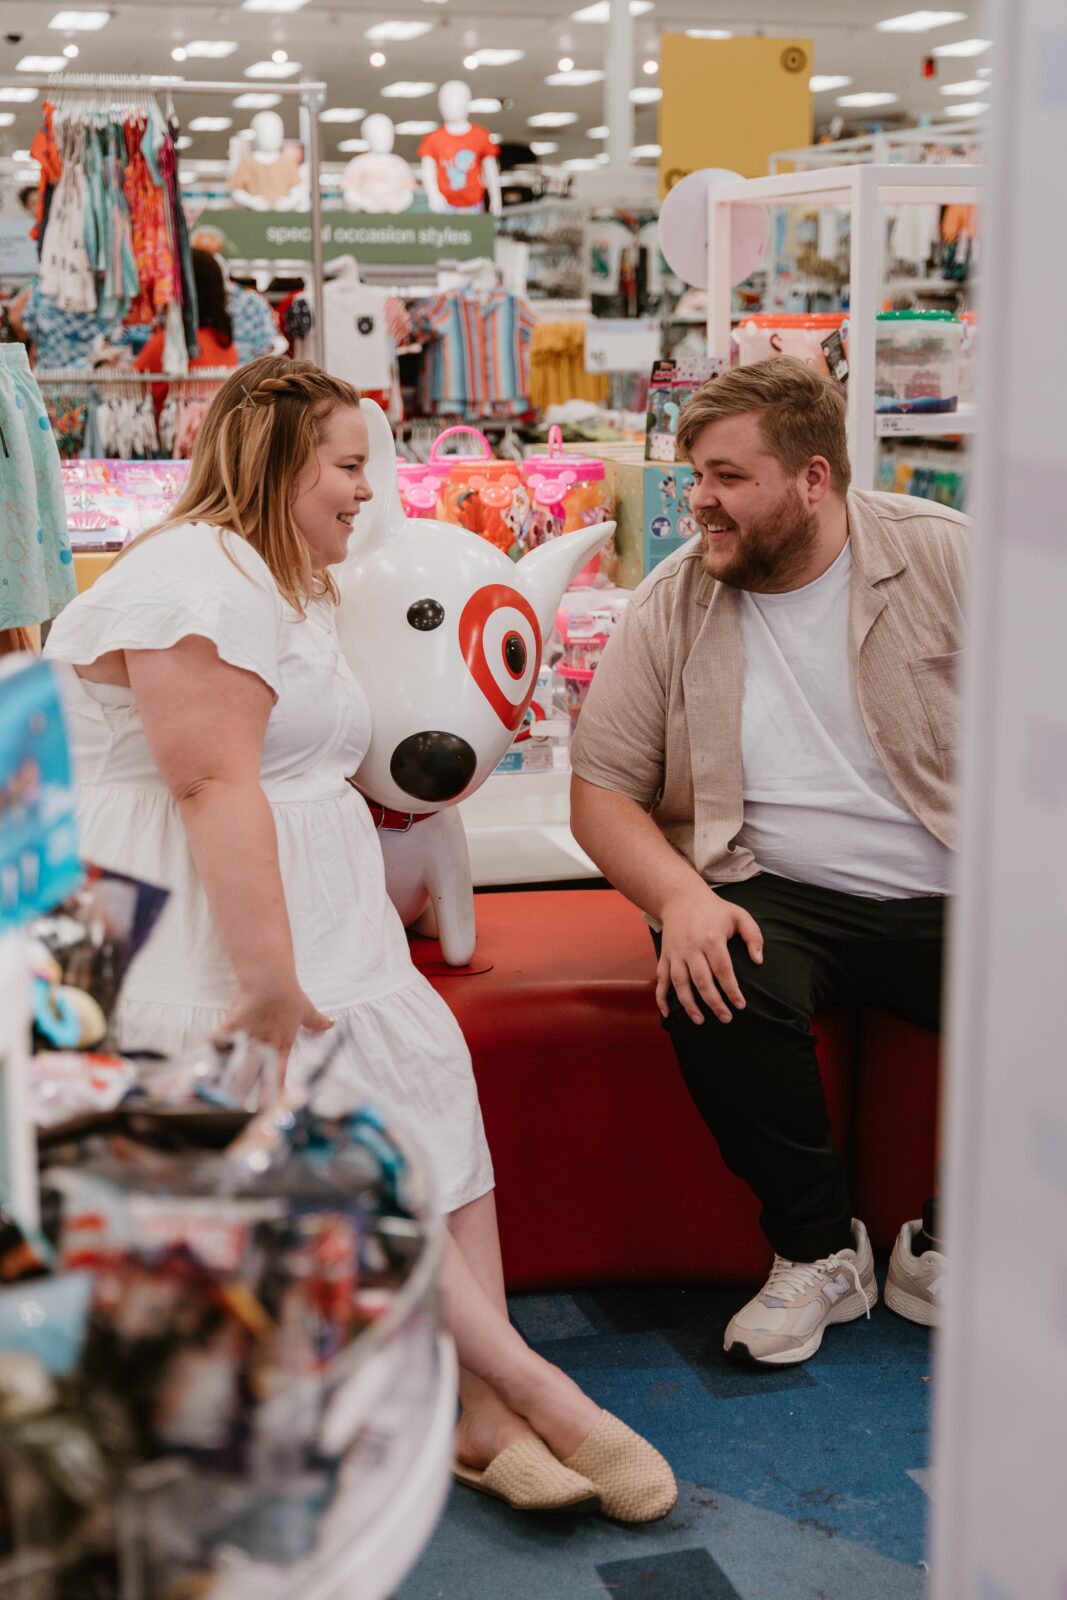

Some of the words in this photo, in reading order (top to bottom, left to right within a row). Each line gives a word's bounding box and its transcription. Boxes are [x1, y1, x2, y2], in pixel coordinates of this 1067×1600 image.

[266, 224, 332, 245] specal
[334, 225, 415, 244] occasion
[418, 227, 472, 247] styles
